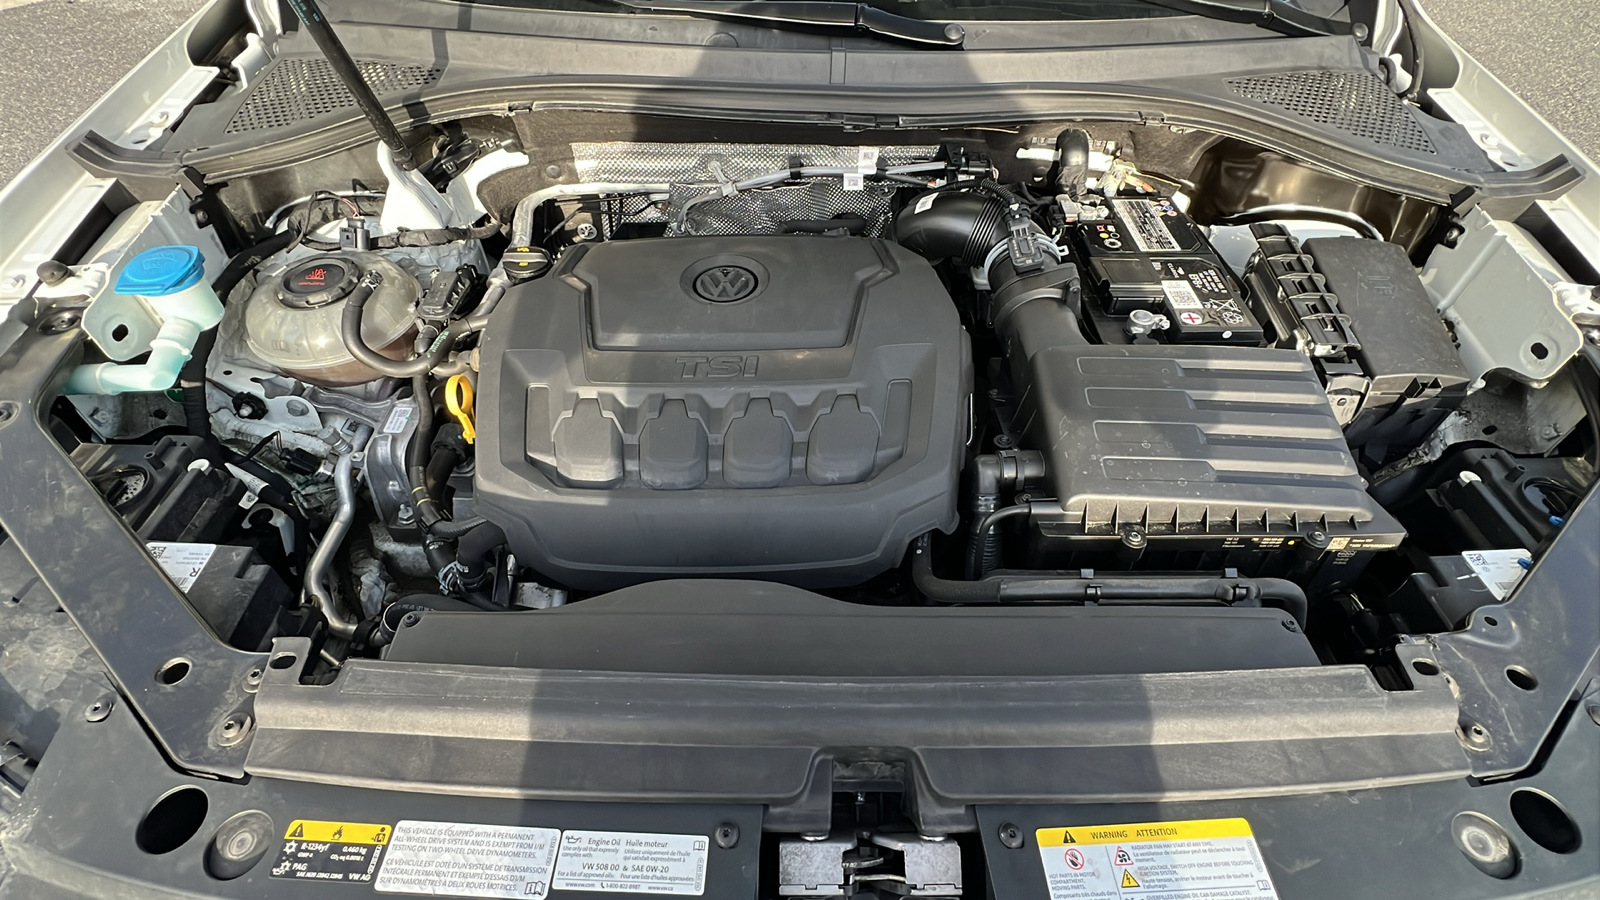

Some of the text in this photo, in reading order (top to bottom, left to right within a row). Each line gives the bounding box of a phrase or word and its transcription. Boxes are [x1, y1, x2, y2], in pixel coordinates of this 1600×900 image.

[694, 266, 757, 302] VW
[675, 355, 760, 378] TSI
[190, 568, 201, 577] R
[394, 835, 427, 843] ALL-WHEEL
[444, 829, 474, 837] EQUIPPED
[498, 832, 534, 840] PERMANENT
[1090, 828, 1178, 839] WARNING ATTENTION
[300, 843, 330, 852] R-1234yf
[588, 838, 609, 846] Engine
[428, 846, 466, 854] TWO-WHEEL
[486, 850, 536, 859] DYNAMOMETERS.
[395, 858, 425, 867] VÉHICULE
[468, 862, 493, 871] SYSTÈME
[504, 865, 547, 874] TRANSMISSION
[383, 867, 415, 876] INTÉGRALE
[414, 869, 451, 878] PERMANENT
[392, 877, 442, 887] DYNAMOMÈTRES
[486, 883, 517, 891] MOTRICES.
